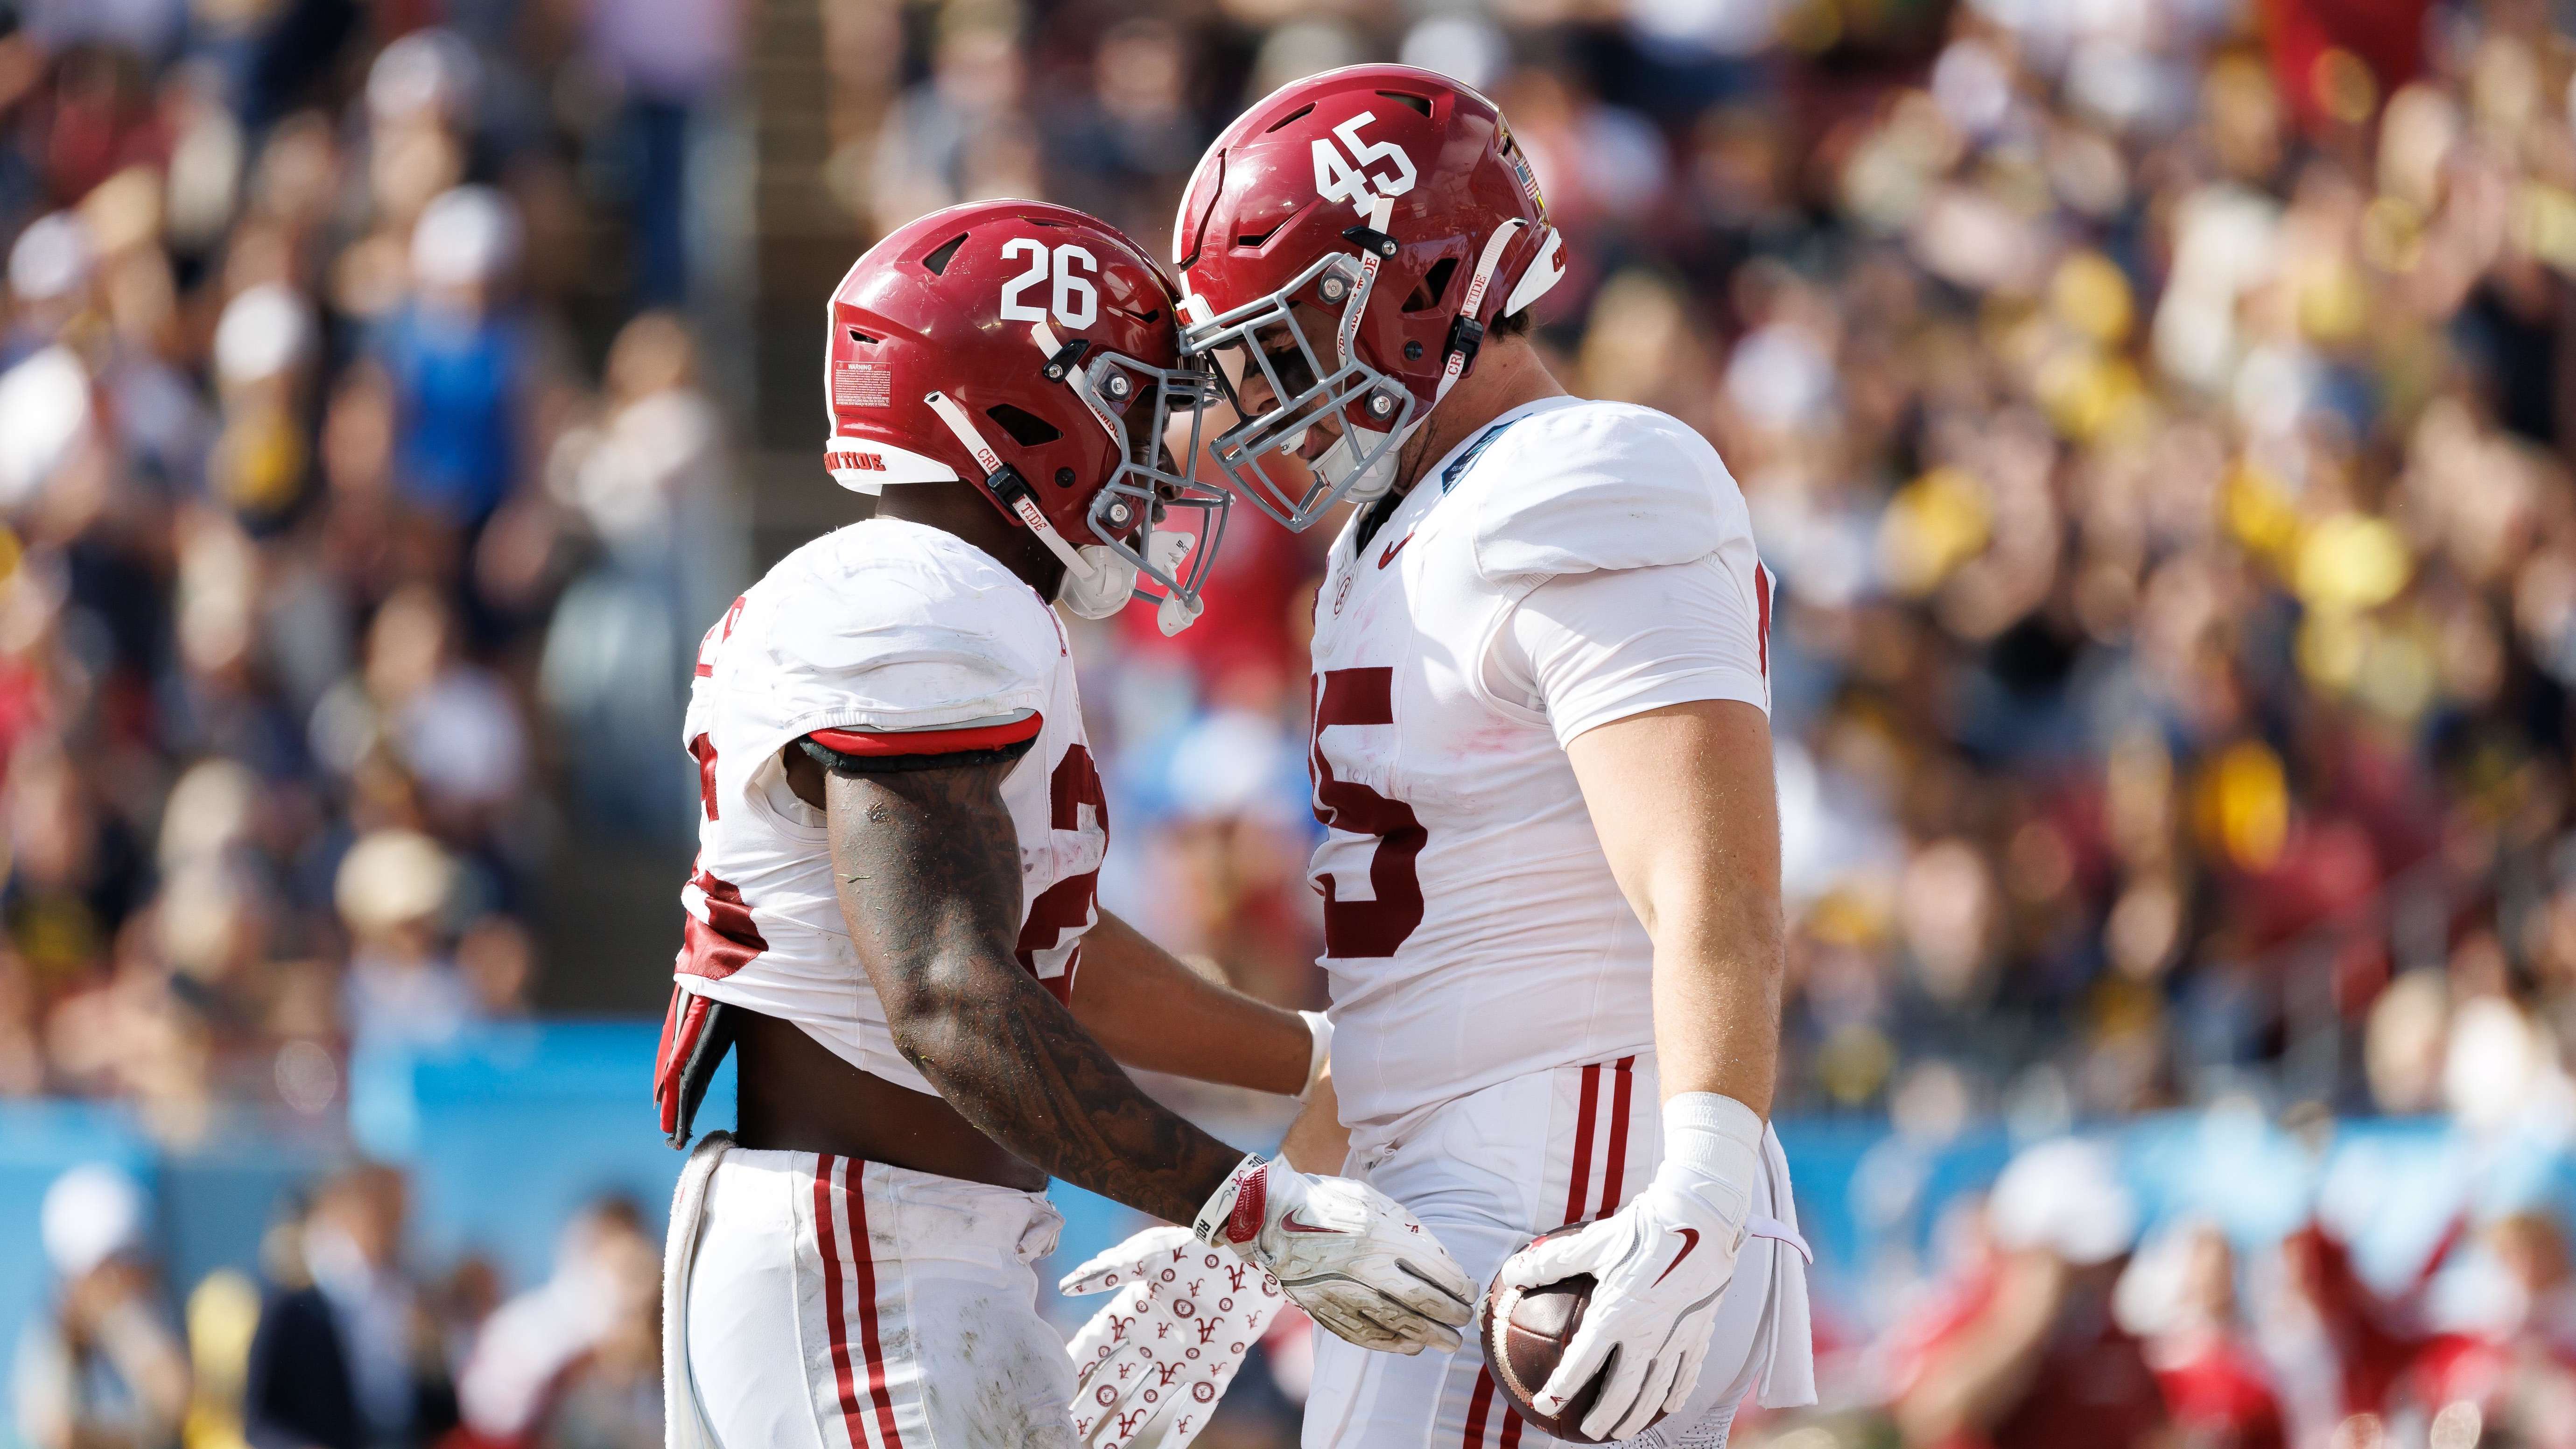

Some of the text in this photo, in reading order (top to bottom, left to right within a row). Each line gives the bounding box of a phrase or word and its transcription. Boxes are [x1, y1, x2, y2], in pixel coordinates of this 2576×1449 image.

[1311, 111, 1417, 218] 45
[1000, 238, 1097, 330] 26
[1466, 274, 1487, 305] TIDE
[840, 451, 886, 471] TIDE
[1021, 502, 1048, 531] TIDE
[1308, 667, 1428, 958] 5
